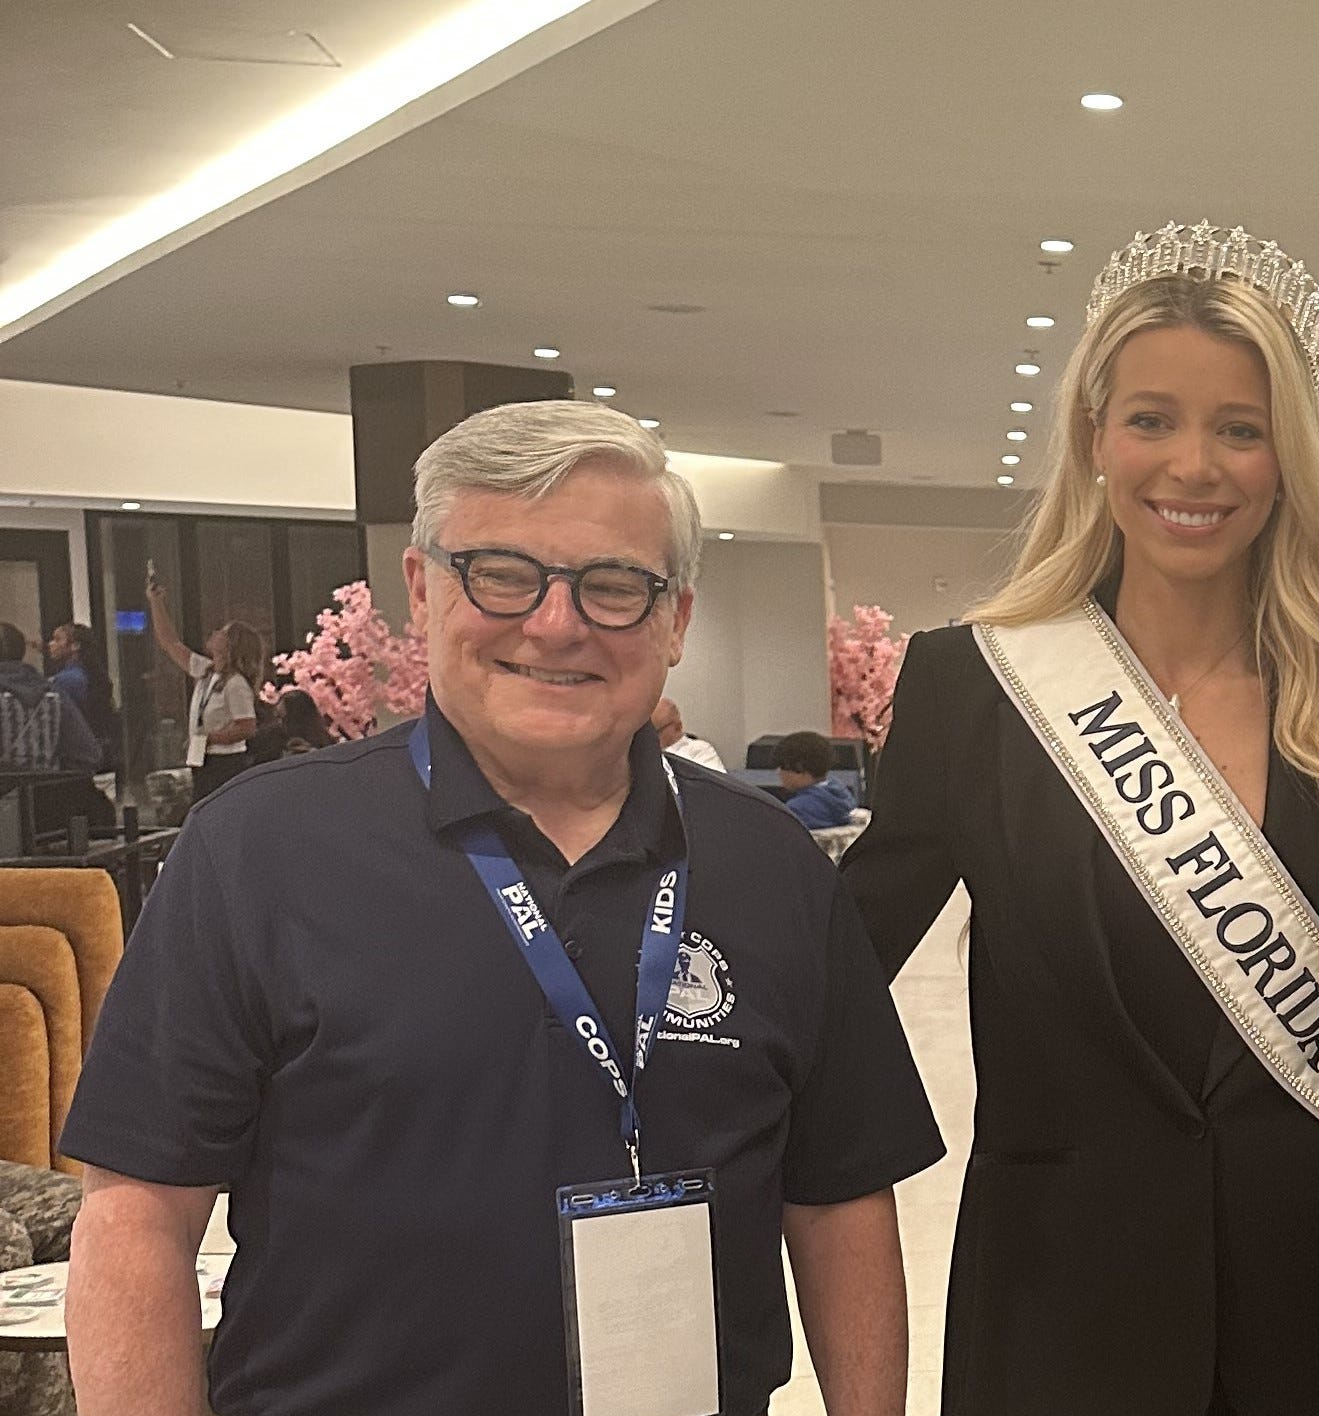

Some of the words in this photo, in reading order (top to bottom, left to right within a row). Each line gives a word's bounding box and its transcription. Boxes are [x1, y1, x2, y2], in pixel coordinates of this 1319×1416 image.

[1067, 690, 1195, 835] MISS
[501, 884, 539, 940] PAL
[516, 881, 548, 932] NATIONAL
[650, 870, 677, 934] KIDS
[690, 931, 729, 971] COPS
[663, 992, 736, 1029] MUNITIES
[575, 1015, 628, 1098] COPS
